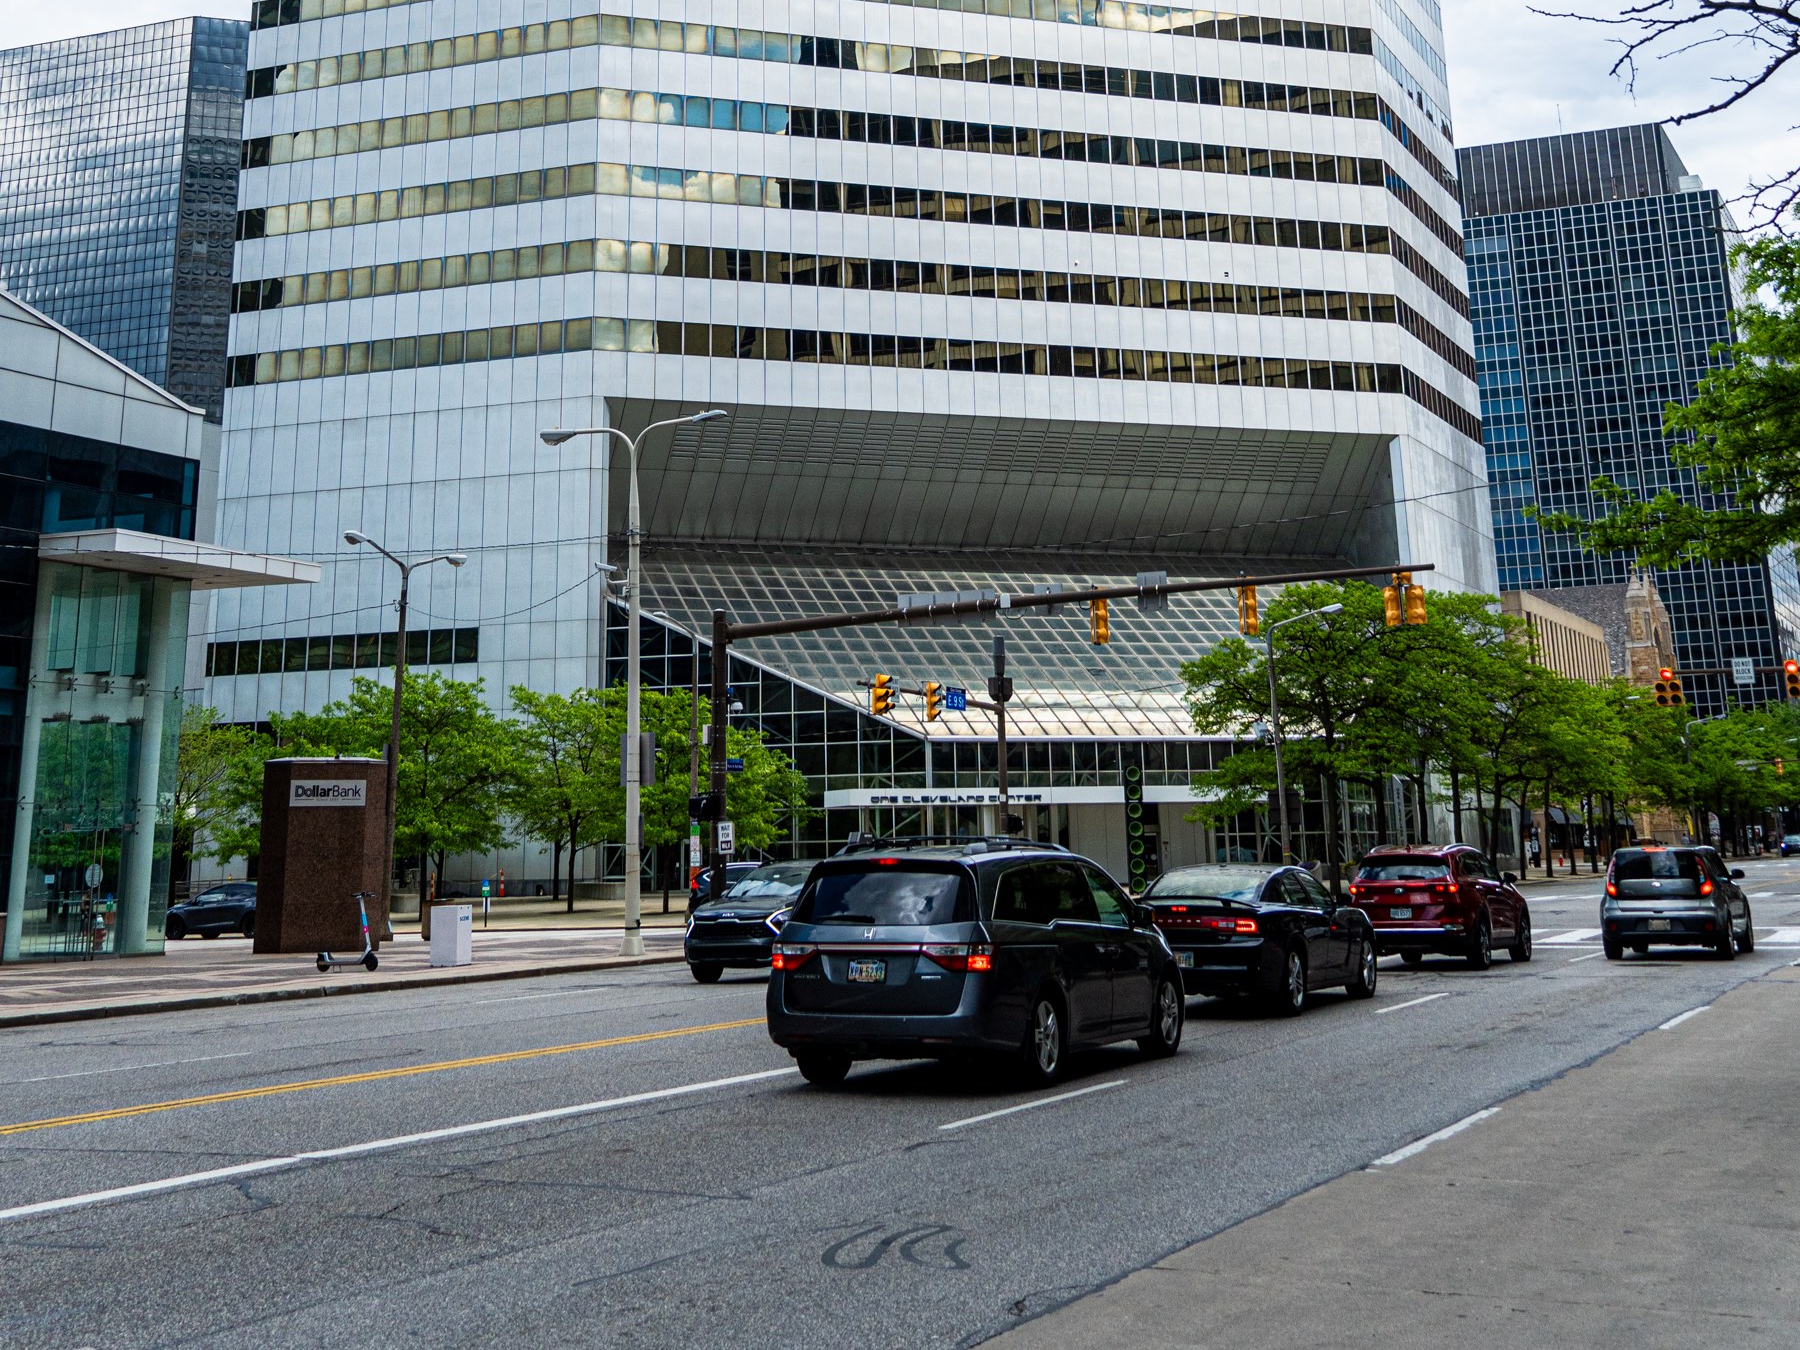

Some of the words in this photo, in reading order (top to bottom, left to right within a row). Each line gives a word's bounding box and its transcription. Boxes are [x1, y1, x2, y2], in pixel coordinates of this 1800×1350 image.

[294, 784, 362, 797] DollarBank
[870, 795, 898, 803] ONE
[902, 794, 985, 803] CLEVELAND
[988, 794, 1042, 802] CNTER
